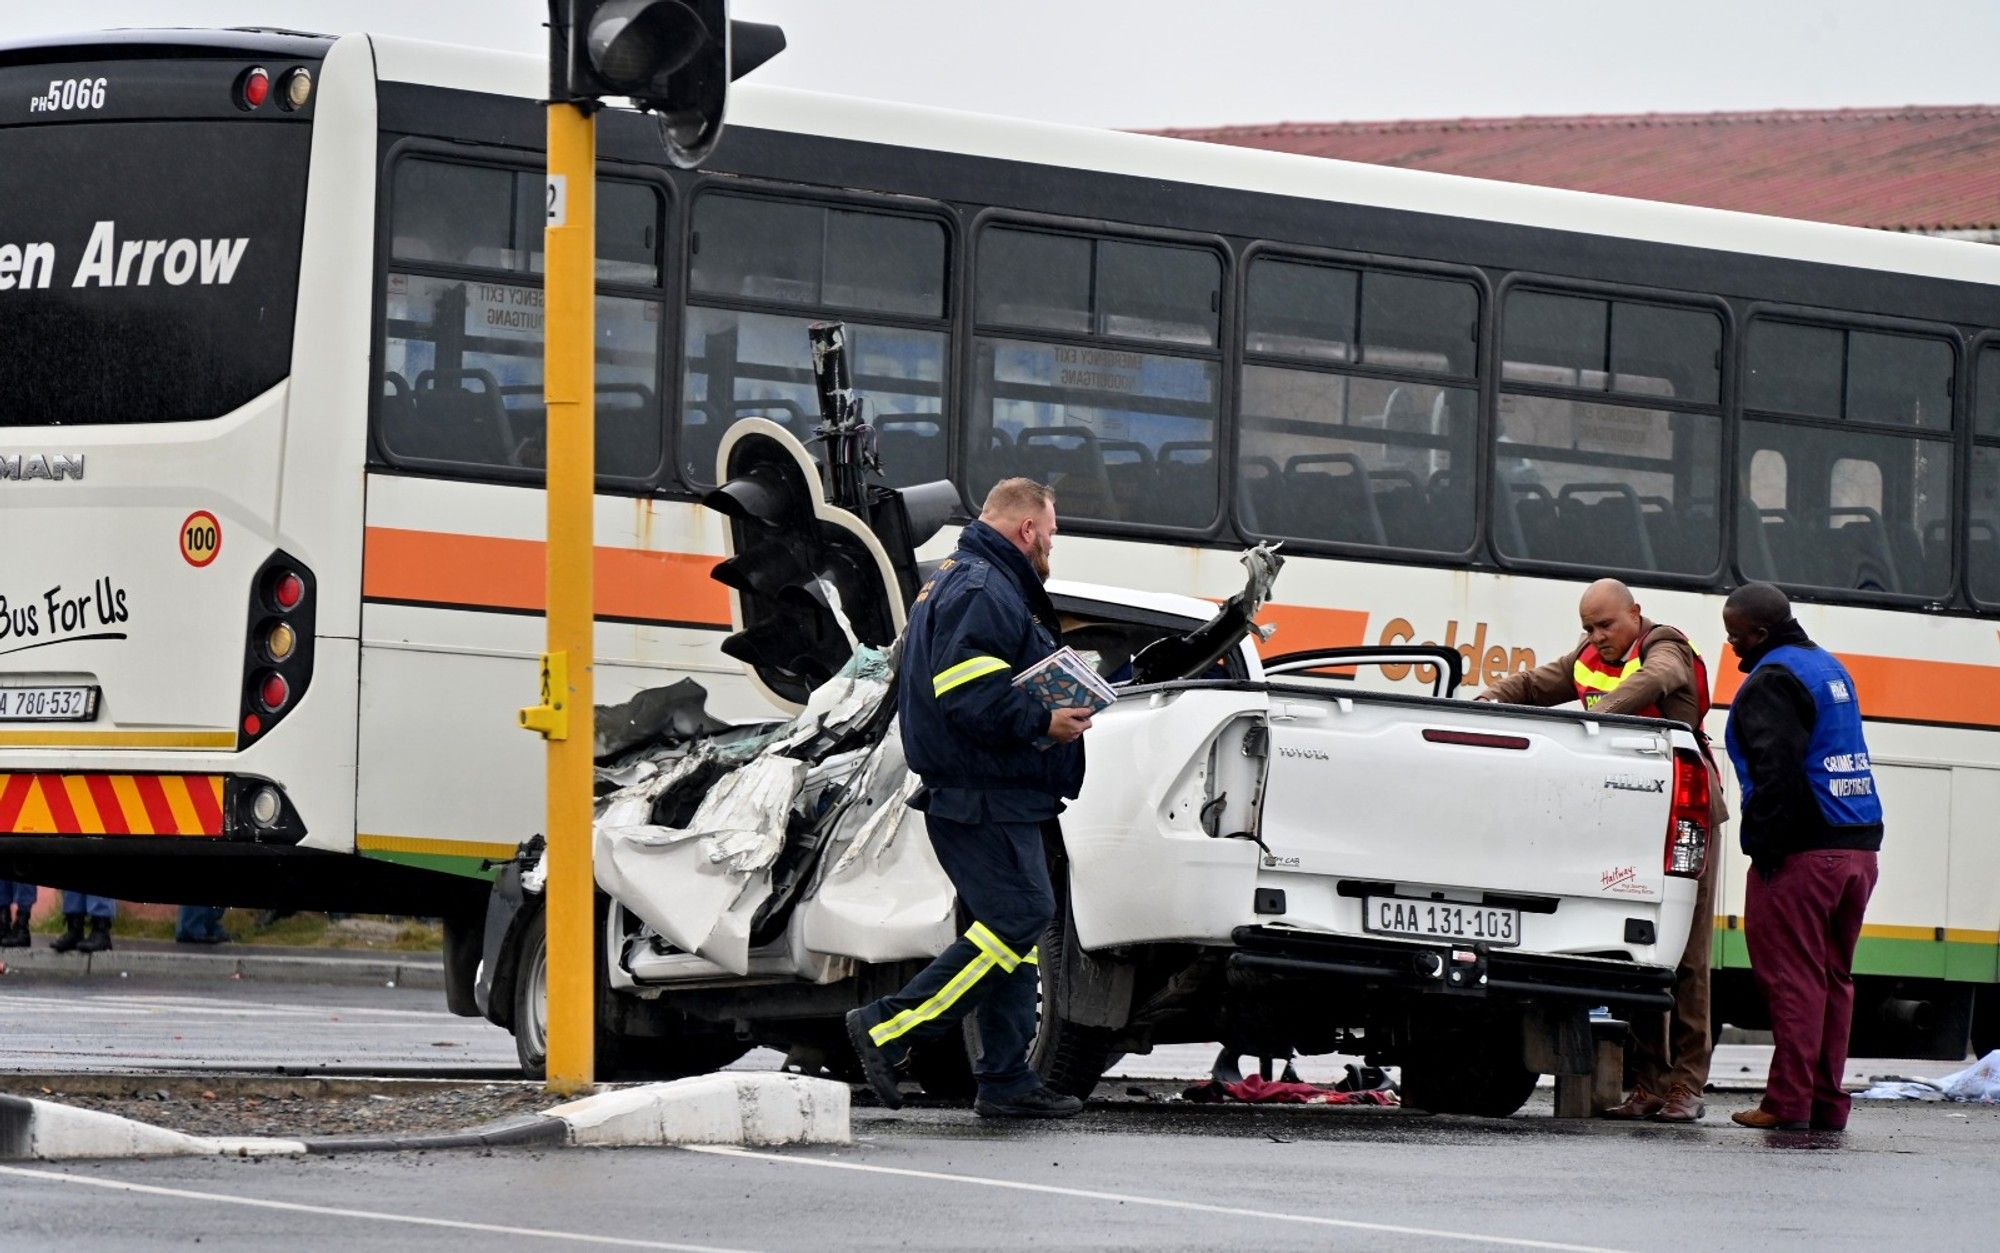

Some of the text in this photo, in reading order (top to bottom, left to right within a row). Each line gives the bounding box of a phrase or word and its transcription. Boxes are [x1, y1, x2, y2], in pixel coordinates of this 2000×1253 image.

[71, 220, 250, 288] Arrow
[186, 526, 216, 551] 100
[43, 584, 91, 634] For
[95, 576, 128, 624] Us
[1279, 746, 1329, 761] TOYOTA
[1824, 754, 1855, 773] CRIME
[1600, 866, 1635, 886] Halfway
[1380, 902, 1512, 938] CAA 131-103
